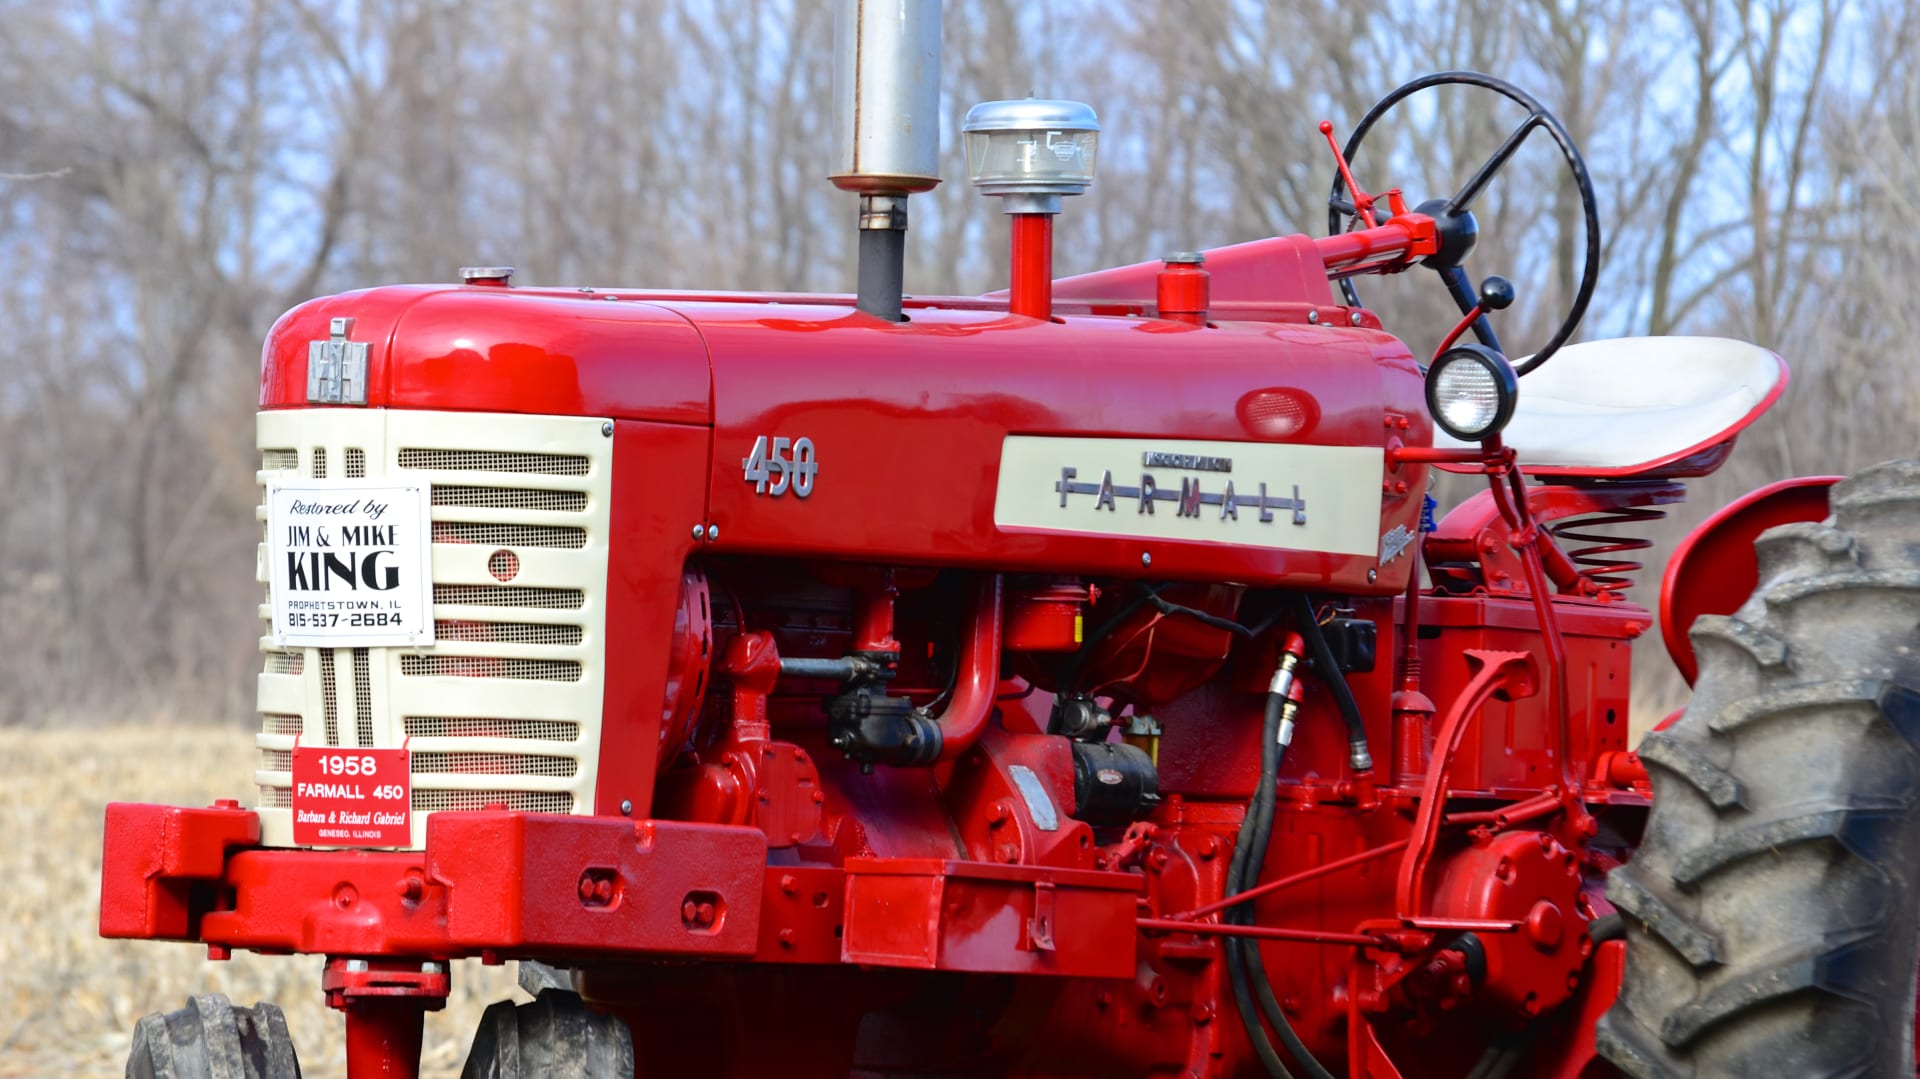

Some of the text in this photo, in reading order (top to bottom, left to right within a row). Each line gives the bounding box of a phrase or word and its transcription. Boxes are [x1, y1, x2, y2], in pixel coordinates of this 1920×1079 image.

[743, 435, 818, 498] 450
[1056, 466, 1307, 525] FARMALL
[290, 499, 389, 520] Restored by
[286, 524, 400, 547] JIM & MIKE
[287, 550, 400, 591] KING
[389, 599, 402, 609] IL
[318, 755, 377, 776] 1958
[297, 782, 404, 800] FARMALL 450
[297, 809, 406, 826] Barbara & Richard Gabriel
[352, 829, 382, 839] ILLINOIS
